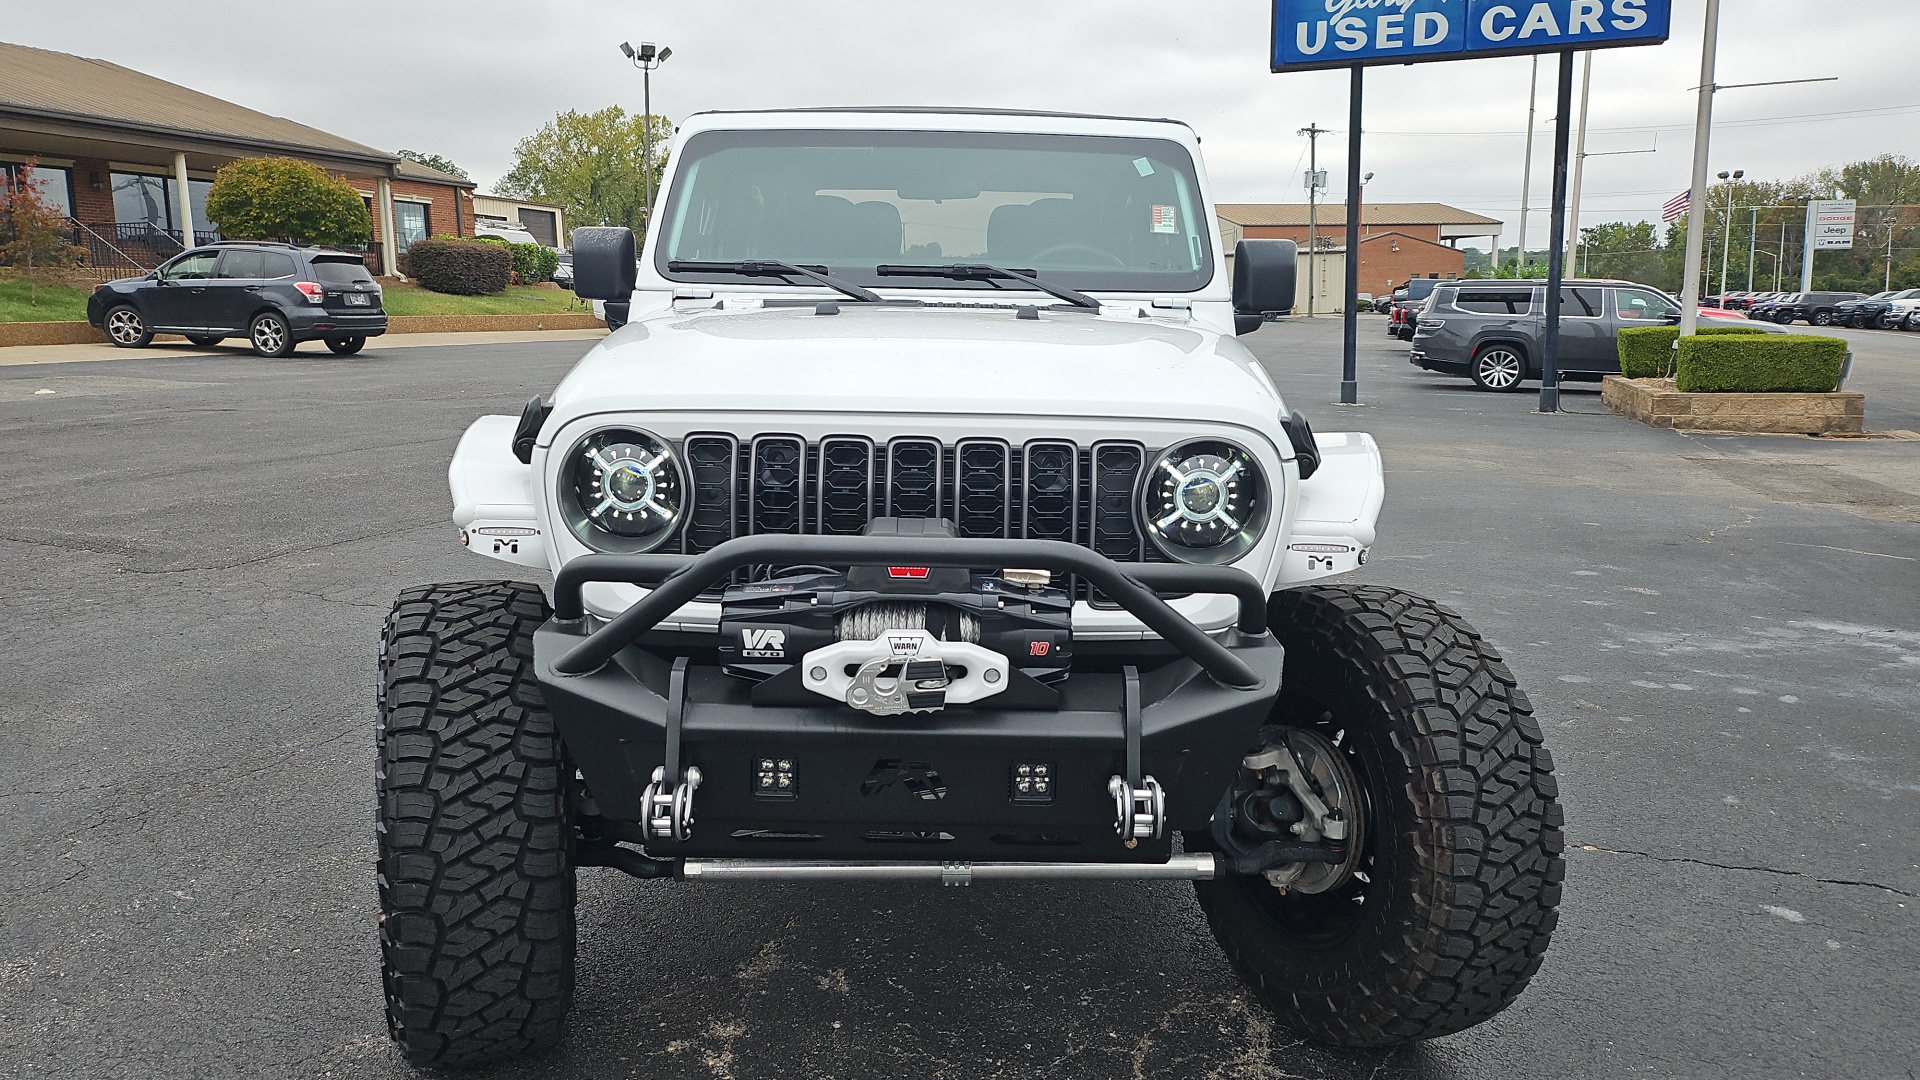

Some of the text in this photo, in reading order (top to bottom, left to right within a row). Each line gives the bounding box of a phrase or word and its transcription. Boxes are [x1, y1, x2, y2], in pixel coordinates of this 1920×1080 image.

[1296, 0, 1648, 55] USED CARS
[1823, 226, 1847, 234] Jeep
[741, 628, 786, 650] VR
[893, 642, 918, 650] WARN
[1029, 641, 1050, 656] 10
